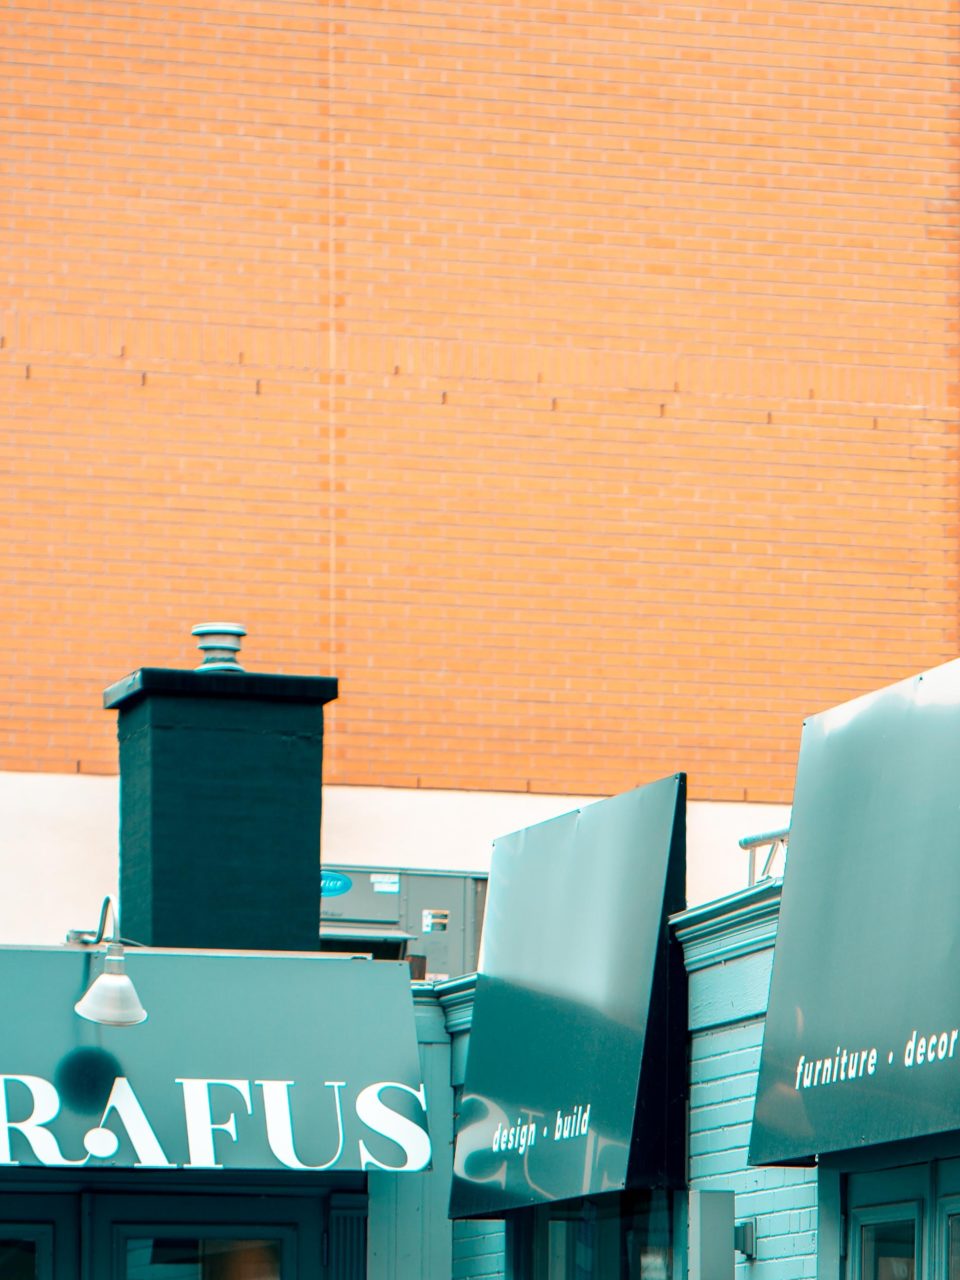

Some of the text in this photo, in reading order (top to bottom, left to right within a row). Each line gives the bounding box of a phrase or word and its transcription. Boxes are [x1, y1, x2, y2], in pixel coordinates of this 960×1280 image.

[794, 1028, 960, 1091] furniture decor
[0, 1074, 433, 1172] RAFUS
[491, 1103, 592, 1155] design build
